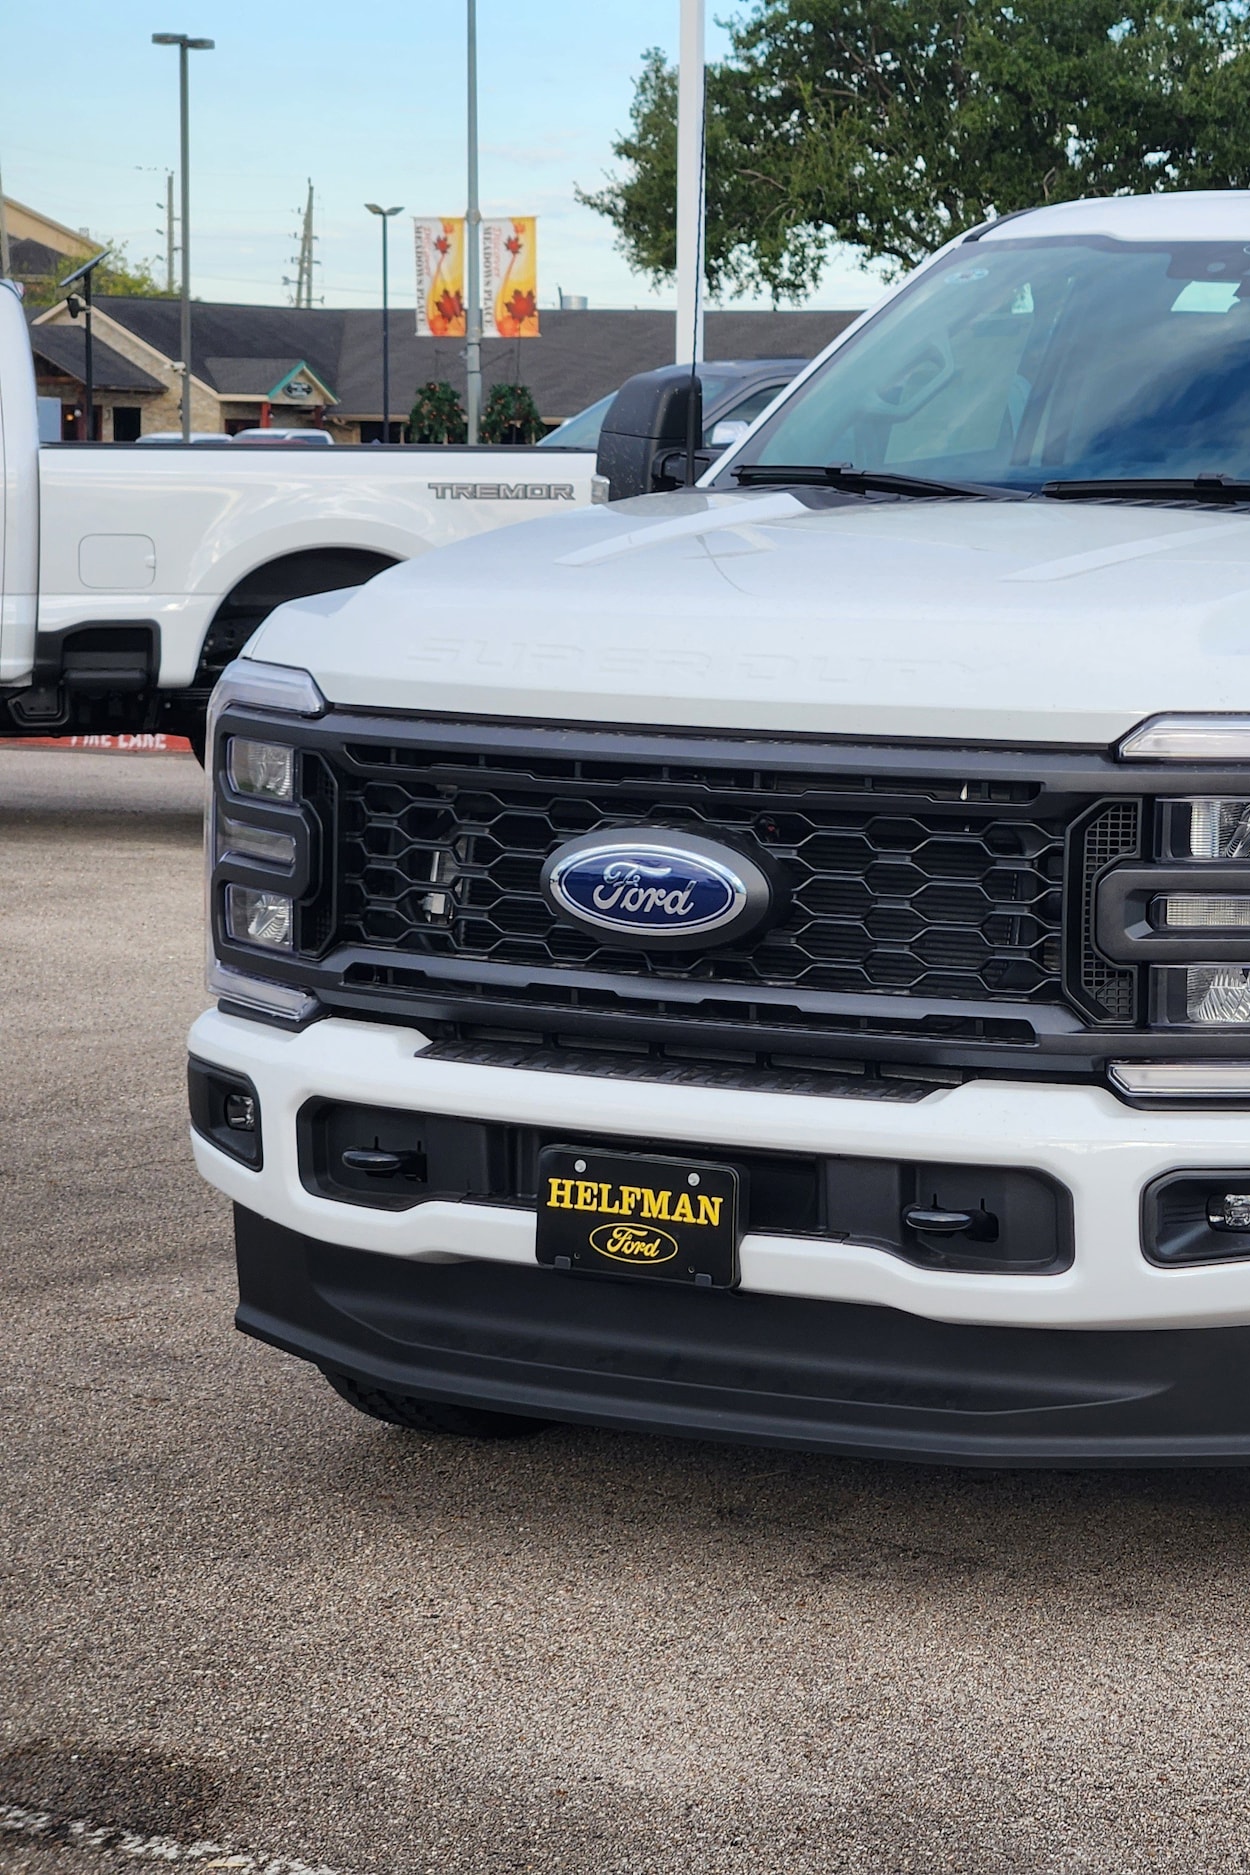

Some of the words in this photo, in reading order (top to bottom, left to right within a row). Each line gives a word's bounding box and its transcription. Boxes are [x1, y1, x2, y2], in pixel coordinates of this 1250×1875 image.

[415, 226, 424, 285] MEADOWS
[482, 226, 493, 286] MEADOWS
[417, 288, 425, 323] PLACE
[483, 289, 493, 325] PLACE
[428, 482, 576, 500] TREMOR
[405, 636, 713, 681] SUPER
[117, 733, 167, 750] LANE
[592, 860, 698, 916] Ford
[546, 1177, 724, 1227] HELFMAN
[606, 1226, 662, 1258] Ford
